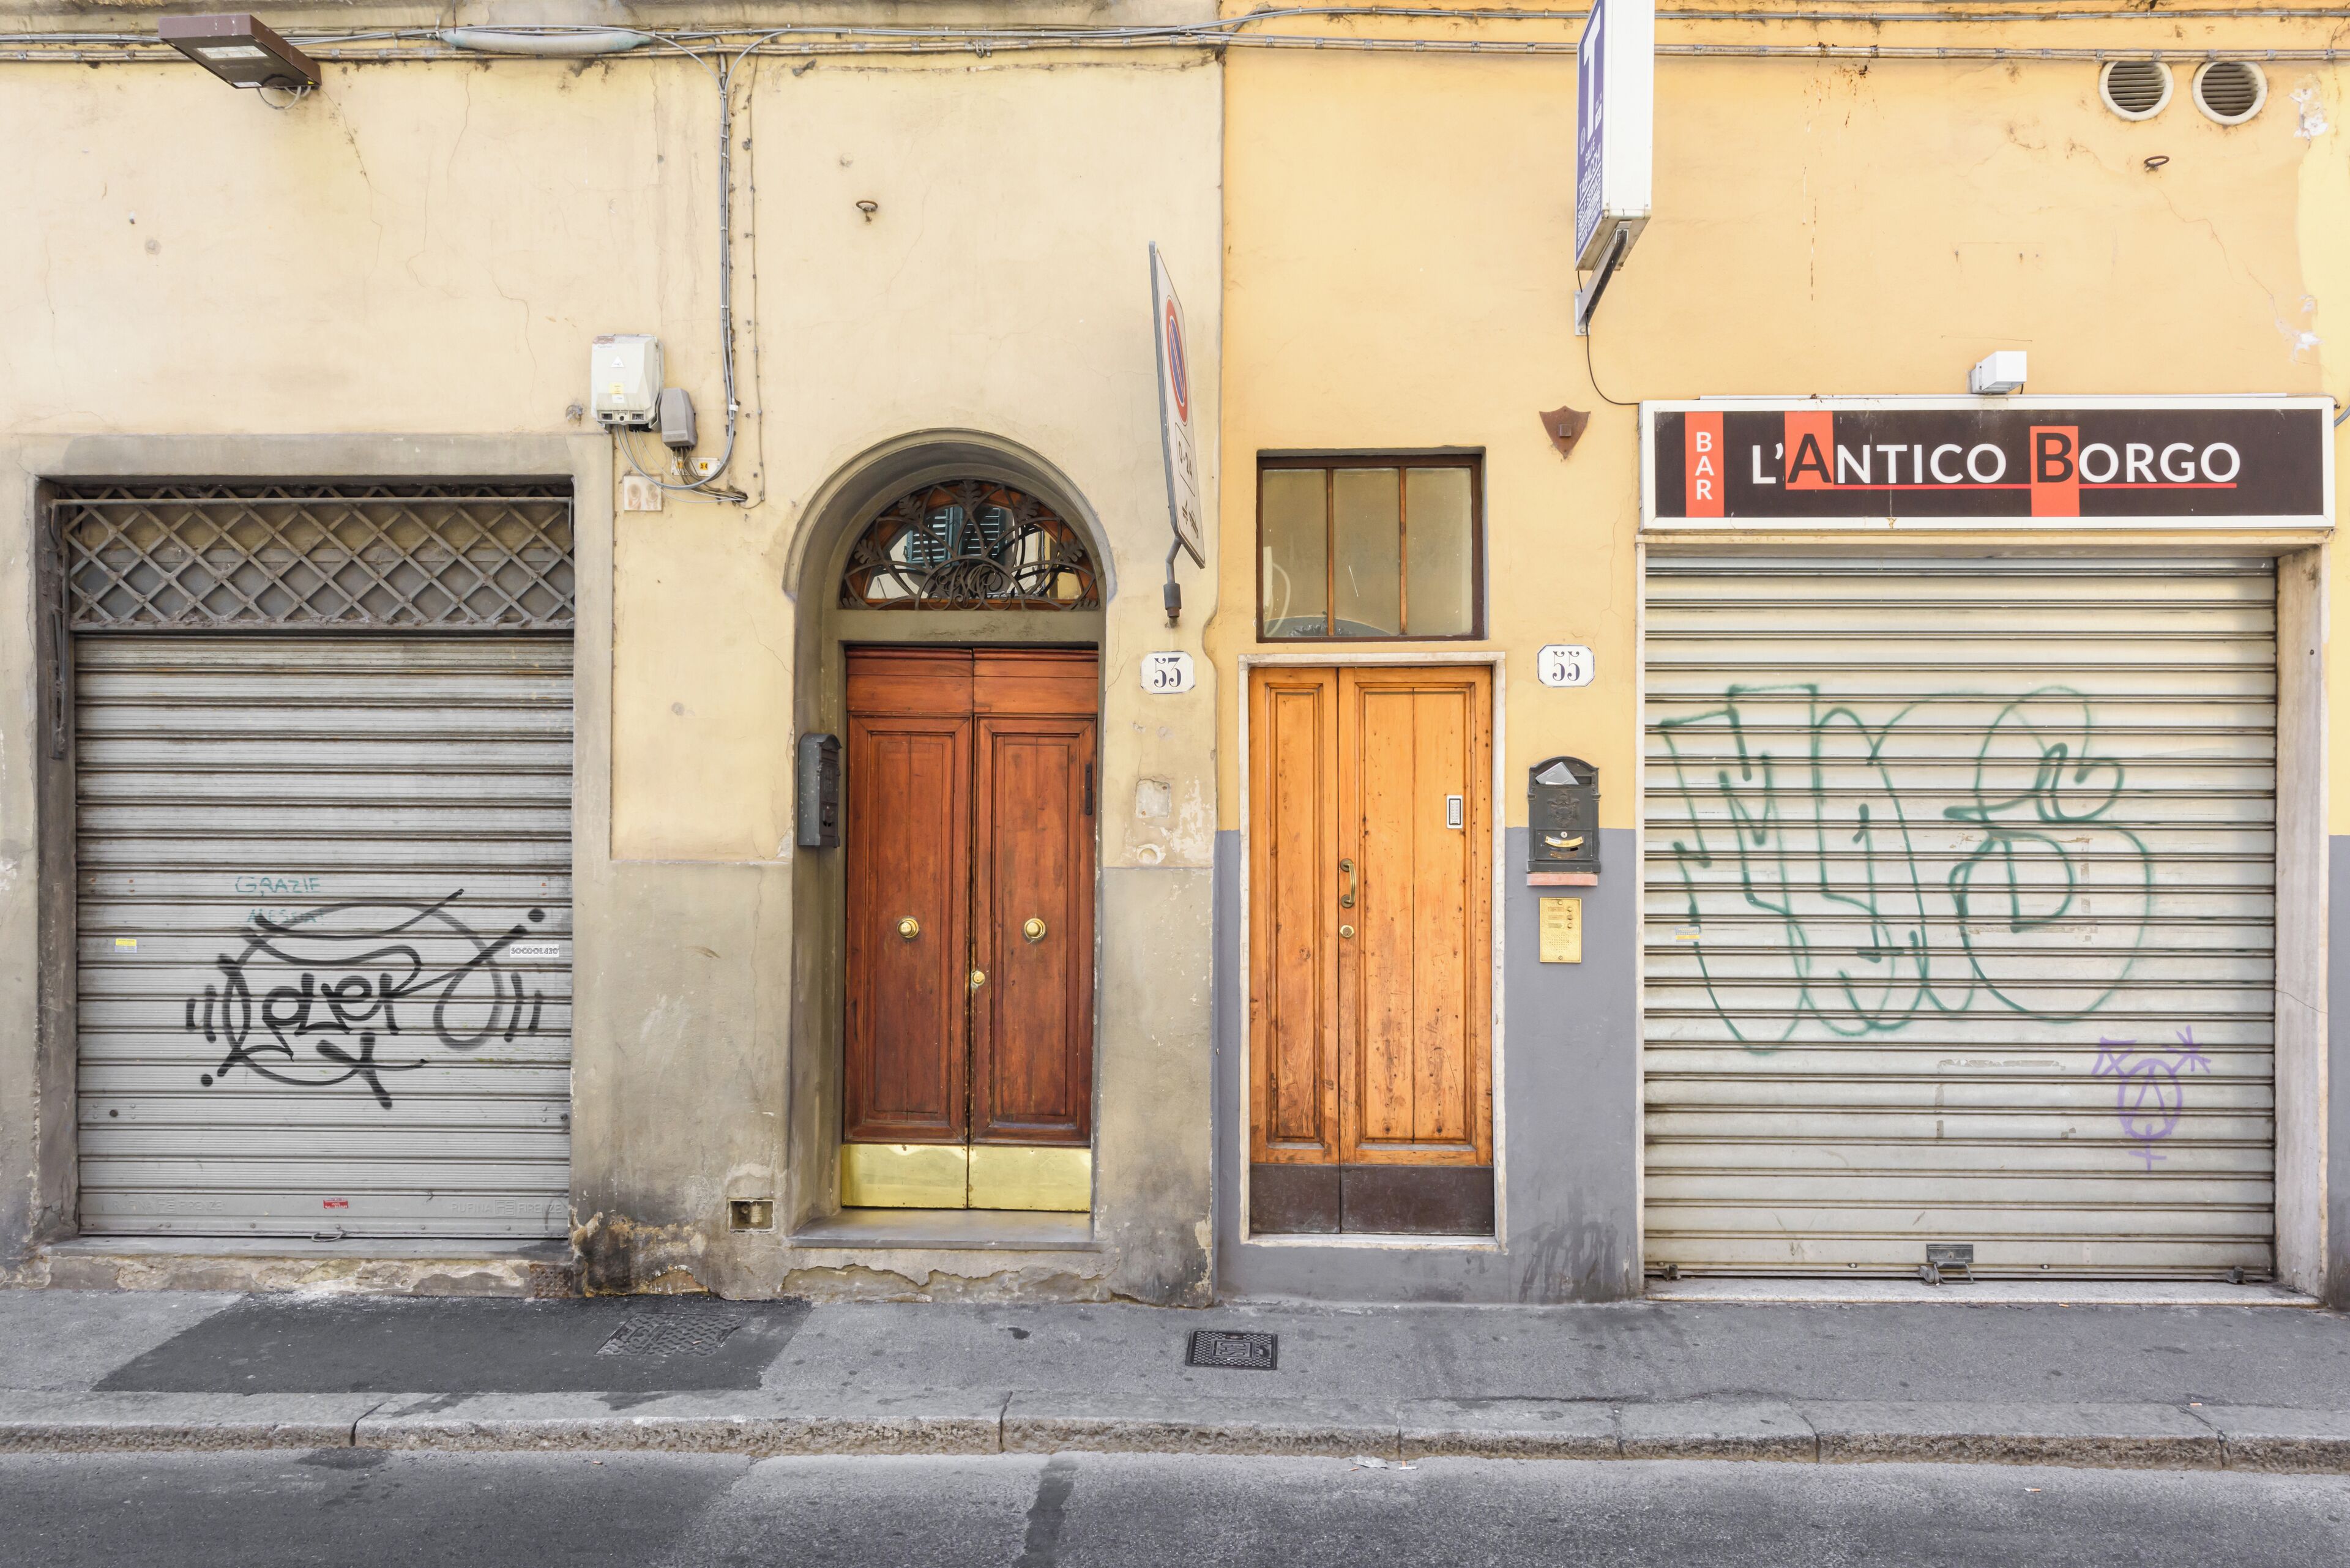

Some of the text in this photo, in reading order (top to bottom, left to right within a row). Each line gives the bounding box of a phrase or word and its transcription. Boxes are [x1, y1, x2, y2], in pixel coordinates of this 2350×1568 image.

[1584, 6, 1601, 142] T
[1579, 142, 1601, 201] TABACCHI
[1695, 431, 1714, 500] BAR
[1752, 432, 2240, 484] L'ANTICO BORGO
[1154, 657, 1182, 688] 53
[1552, 651, 1580, 681] 55
[235, 876, 321, 897] GRAZIE
[1219, 1342, 1247, 1356] GAS
